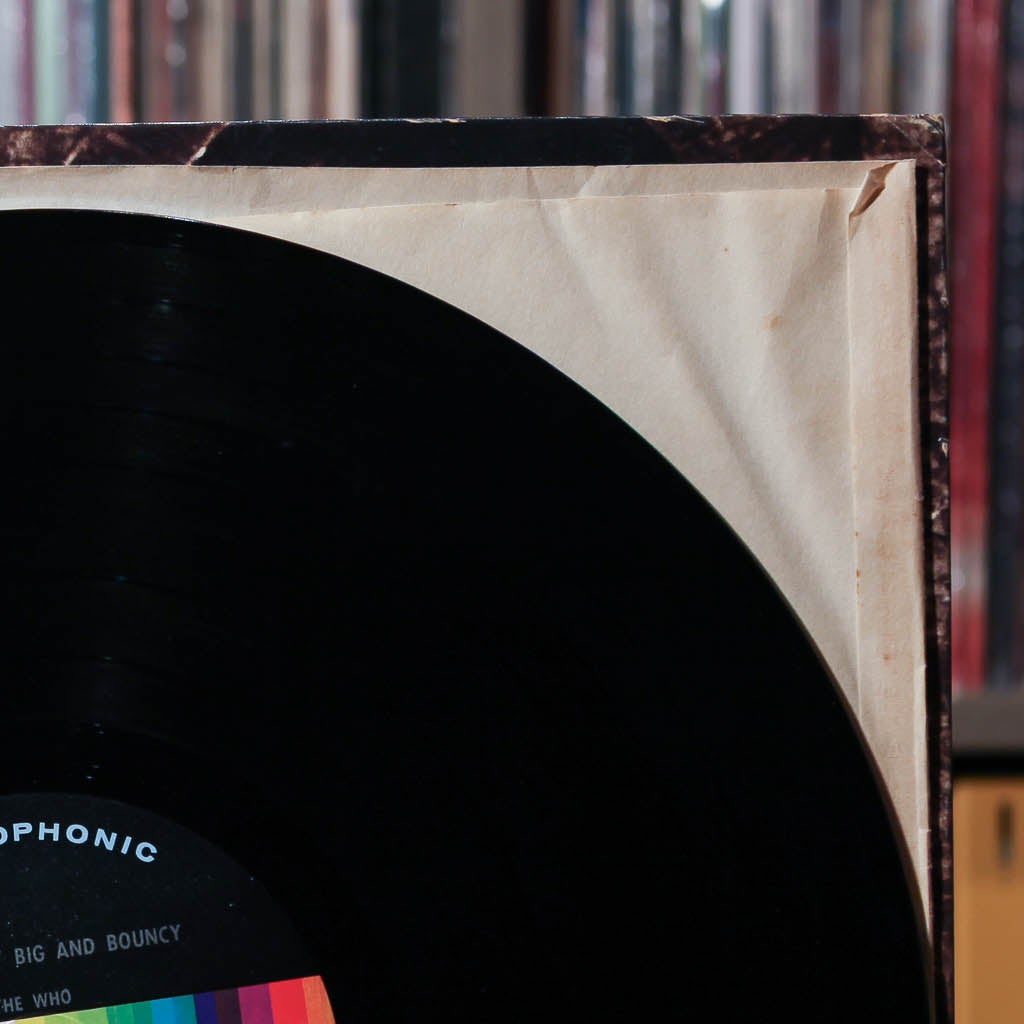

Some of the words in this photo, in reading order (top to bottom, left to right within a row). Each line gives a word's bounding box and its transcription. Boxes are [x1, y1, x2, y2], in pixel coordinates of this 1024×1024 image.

[14, 944, 46, 966] BIG
[57, 937, 95, 961] AND
[106, 924, 182, 952] BOUNCY
[32, 988, 72, 1009] WHO
